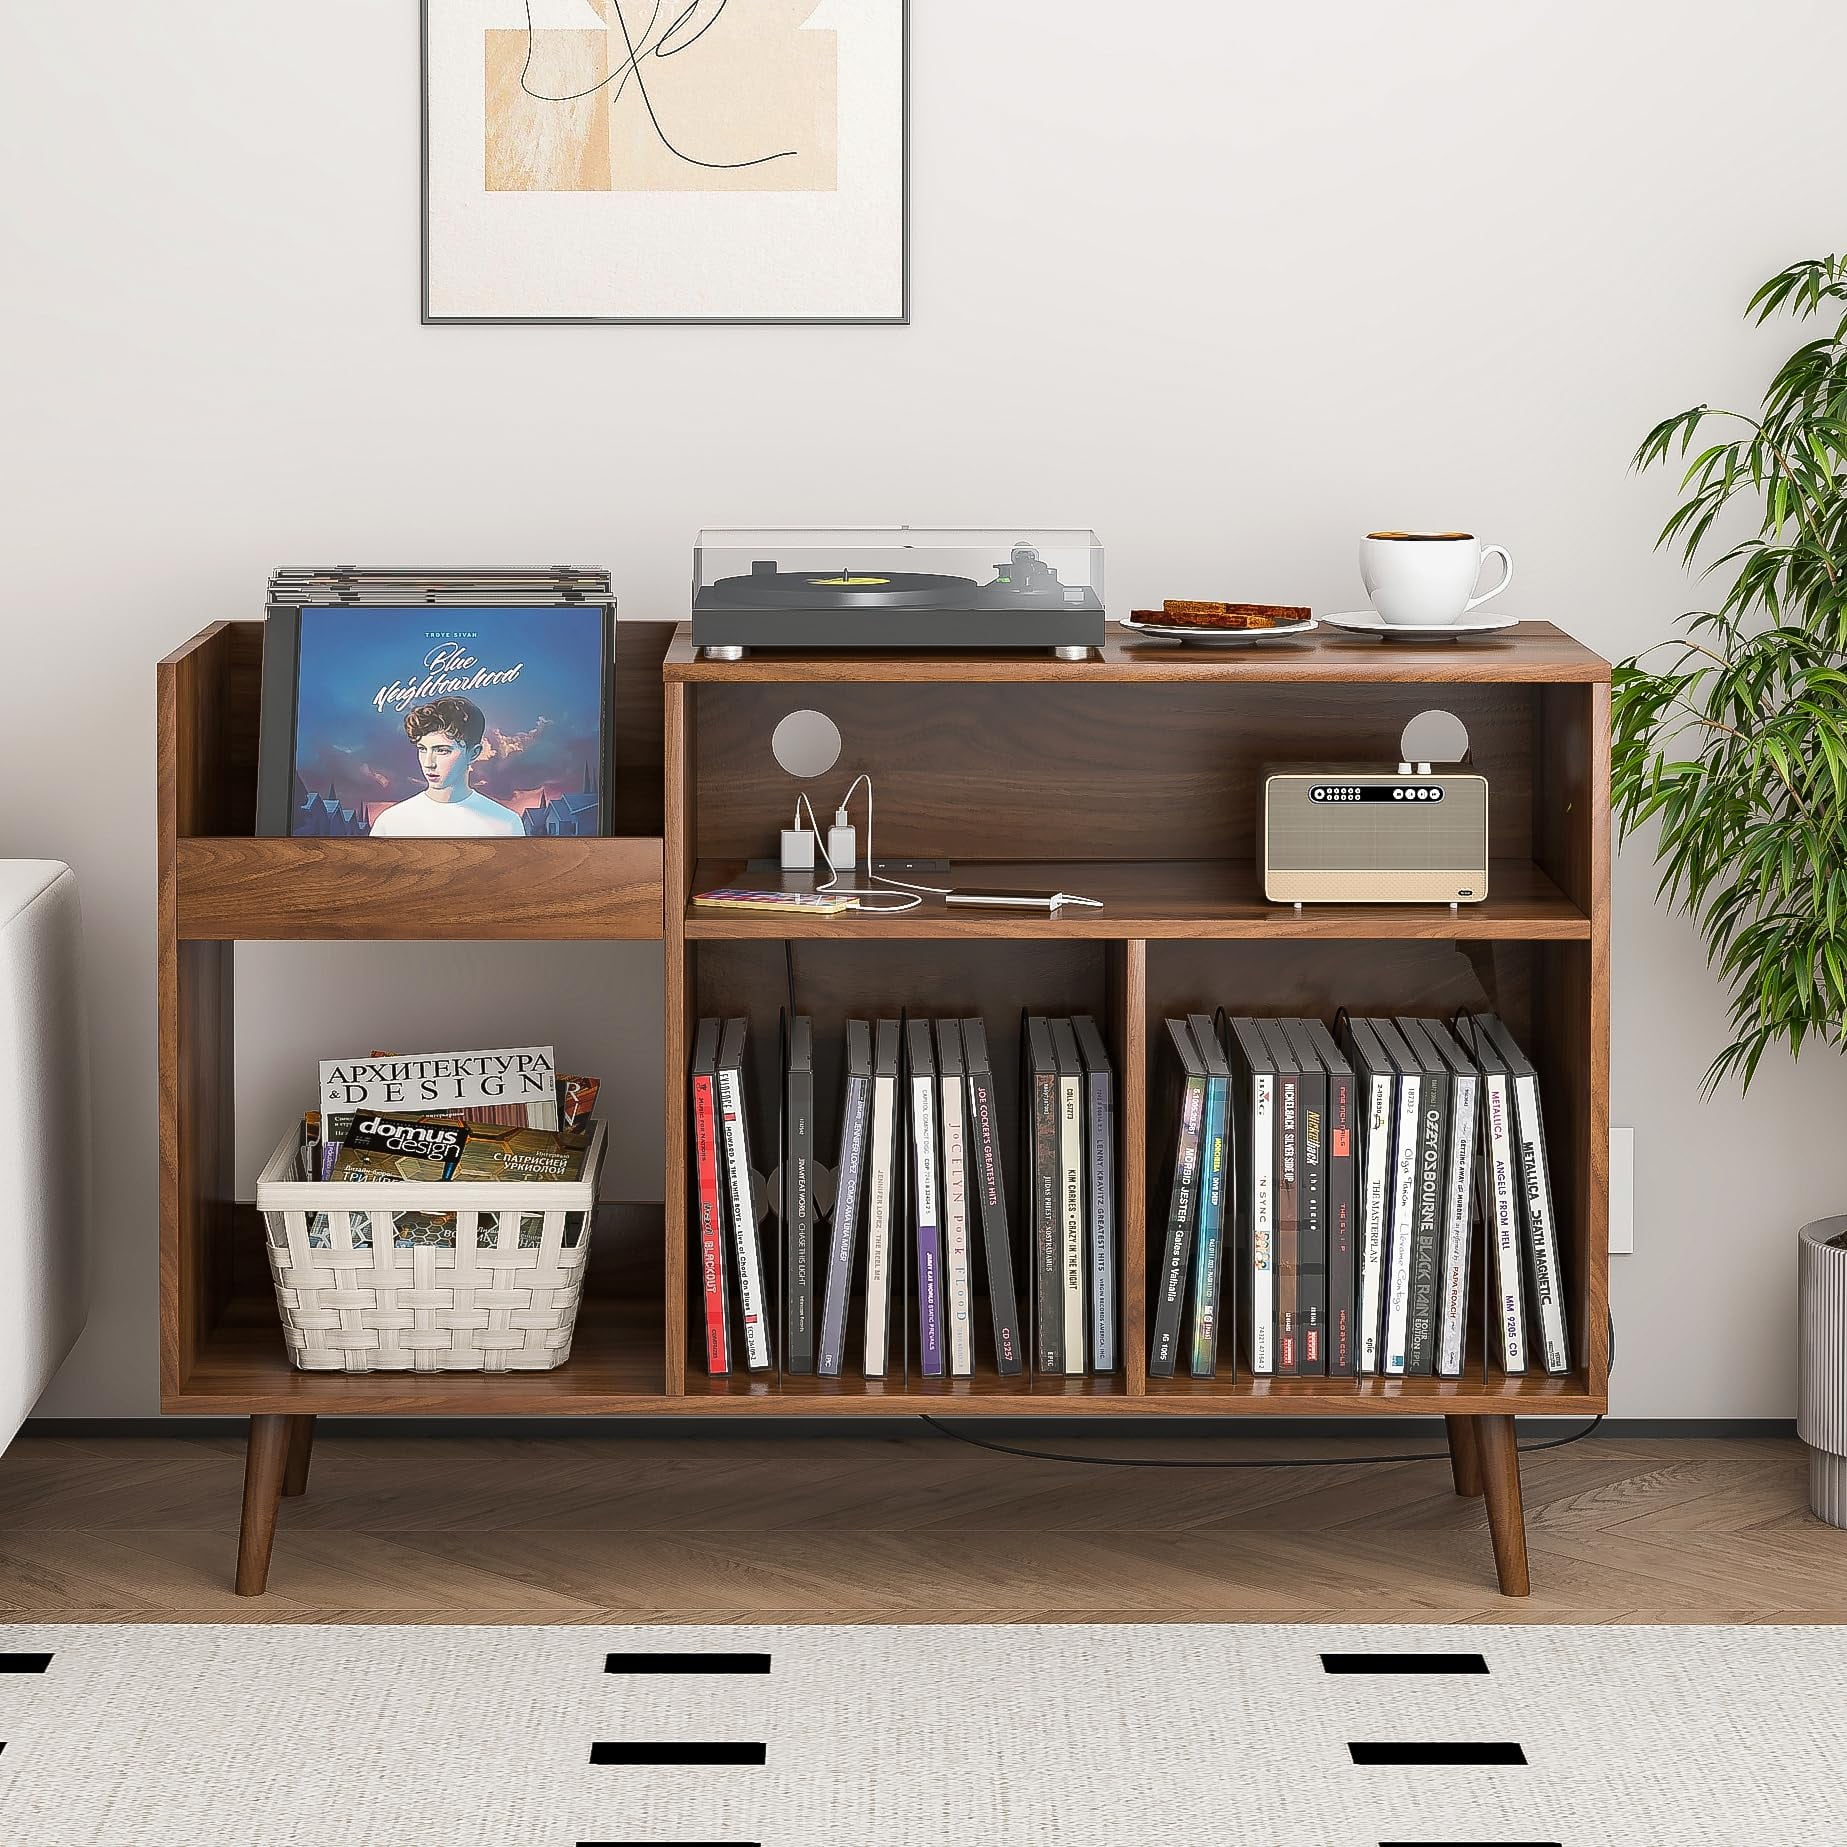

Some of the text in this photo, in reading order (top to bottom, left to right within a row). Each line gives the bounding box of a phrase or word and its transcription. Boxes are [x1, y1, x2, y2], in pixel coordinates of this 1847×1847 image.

[423, 641, 478, 676] Blue
[372, 663, 524, 713] Neighbourhood
[327, 1053, 554, 1085] АРХИТЕКТУРА
[329, 1090, 340, 1099] &
[343, 1072, 545, 1104] DESIGN
[359, 1117, 458, 1145] domus
[726, 1127, 734, 1158] HOWARD
[852, 1122, 861, 1152] JENNIFER
[1284, 1083, 1294, 1182] NICKELBACK SILVER SIDE UP
[1306, 1110, 1320, 1166] Nickelback
[1426, 1110, 1439, 1148] OZZY
[386, 1133, 461, 1161] design
[503, 1153, 568, 1167] ПАТРИСИЕЙ
[978, 1087, 997, 1206] JOE COCKER'S GREATEST HITS
[1459, 1139, 1467, 1165] GETTING
[849, 1153, 858, 1174] LOPEZ
[1401, 1148, 1413, 1174] Olga
[1491, 1091, 1510, 1250] METALLICA ANGELS FROM HELL
[1043, 1176, 1051, 1195] JUDAS
[1068, 1170, 1076, 1183] KIM
[1212, 1177, 1220, 1190] DIVE
[846, 1180, 855, 1204] COMO
[1068, 1185, 1076, 1212] CARNES
[1420, 1150, 1438, 1232] OSBOURNE
[844, 1205, 853, 1222] AMA
[1044, 1198, 1052, 1220] PRIEST
[1370, 1180, 1380, 1263] THE MASTERPLAN
[842, 1222, 851, 1238] UNA
[1069, 1221, 1077, 1242] CRAZY
[1097, 1208, 1105, 1249] GREATEST
[1167, 1148, 1194, 1302] MORBID JESTER Gates to Valhalla
[1523, 1142, 1551, 1305] METALLICA DEATH MAGNETIC
[839, 1239, 850, 1262] MUJER
[1045, 1226, 1053, 1272] NOSTRADAMUS
[1069, 1255, 1077, 1267] THE
[1418, 1236, 1433, 1280] BLACK
[704, 1241, 716, 1293] BLACKOUT
[740, 1257, 748, 1278] Chord
[874, 1270, 880, 1281] ME
[1069, 1270, 1078, 1290] NIGHT
[743, 1280, 748, 1290] On
[1416, 1284, 1430, 1317] RAIN
[1450, 1290, 1458, 1318] ROACH
[1506, 1295, 1518, 1356] MM 9205 CD
[1002, 1328, 1012, 1361] CD 3257
[1160, 1344, 1168, 1360] 1005
[1366, 1338, 1374, 1353] epic
